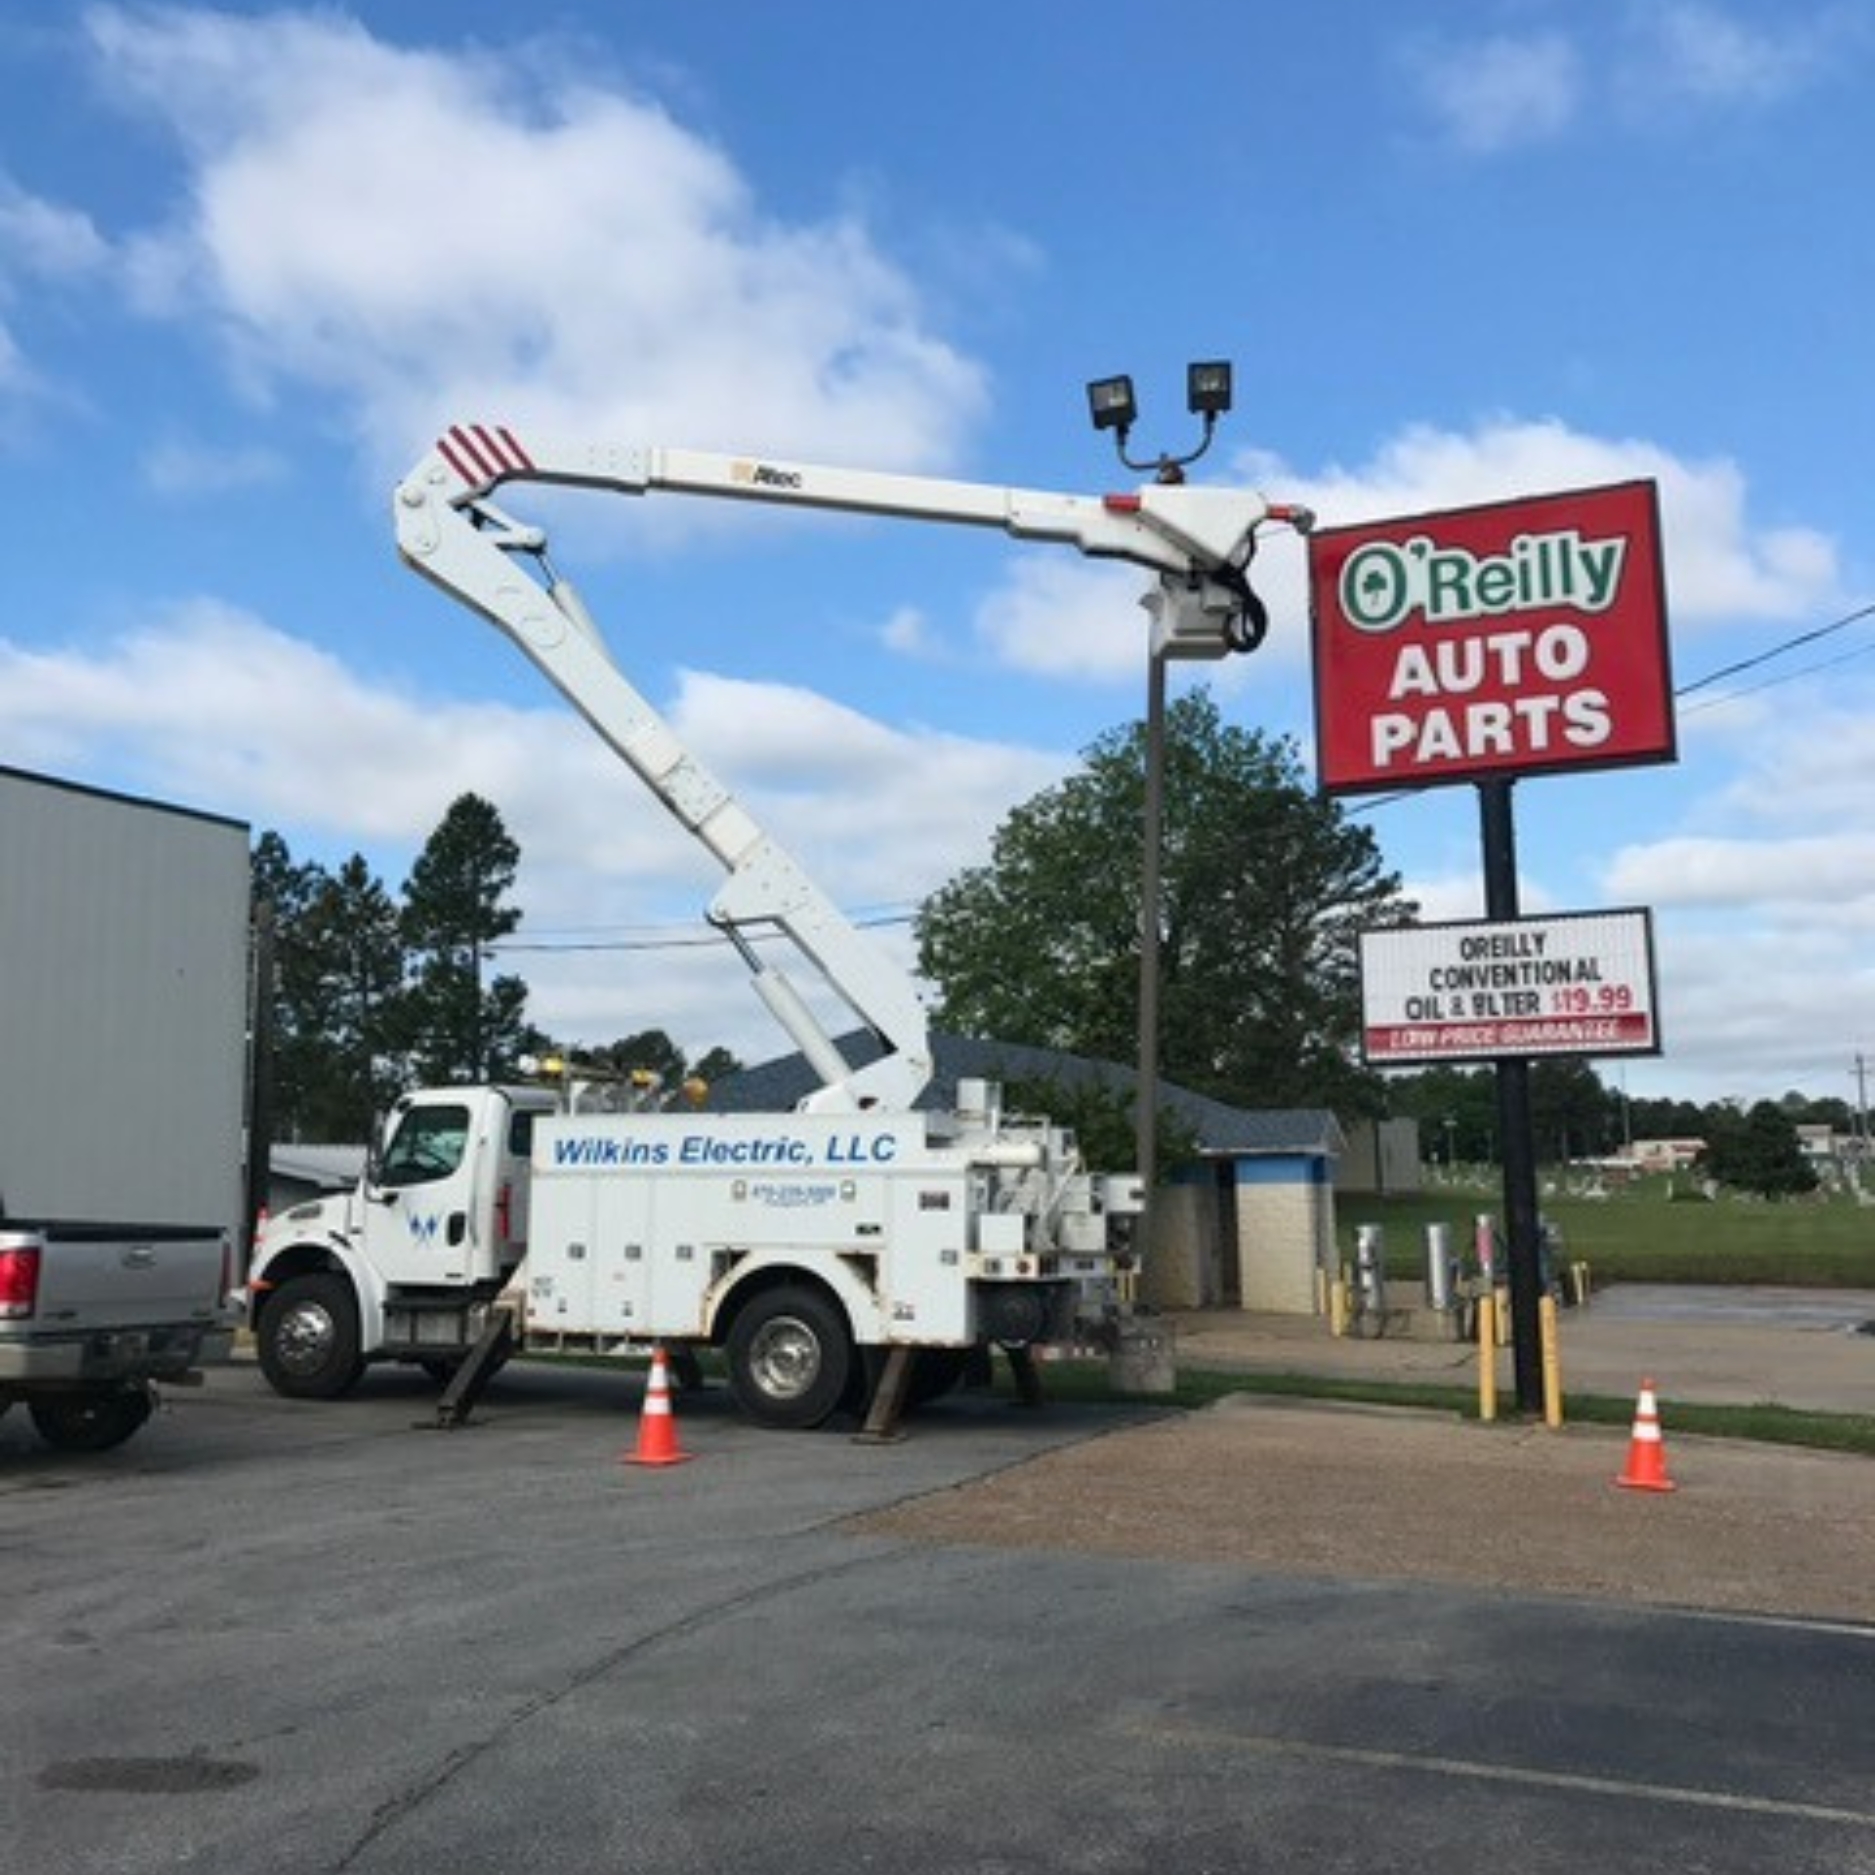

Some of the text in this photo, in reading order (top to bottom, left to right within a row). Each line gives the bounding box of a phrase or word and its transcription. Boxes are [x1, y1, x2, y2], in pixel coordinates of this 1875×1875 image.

[1341, 534, 1621, 628] O'Reilly
[1389, 624, 1588, 699] AUTO
[1371, 690, 1612, 767] PARTS
[1460, 932, 1546, 960] OREILLY
[1429, 957, 1602, 990] CONVENTIONAL
[1406, 995, 1445, 1020] OIL
[1440, 1023, 1495, 1046] PRICE
[554, 1135, 896, 1165] Wilkins Electric, LLC
